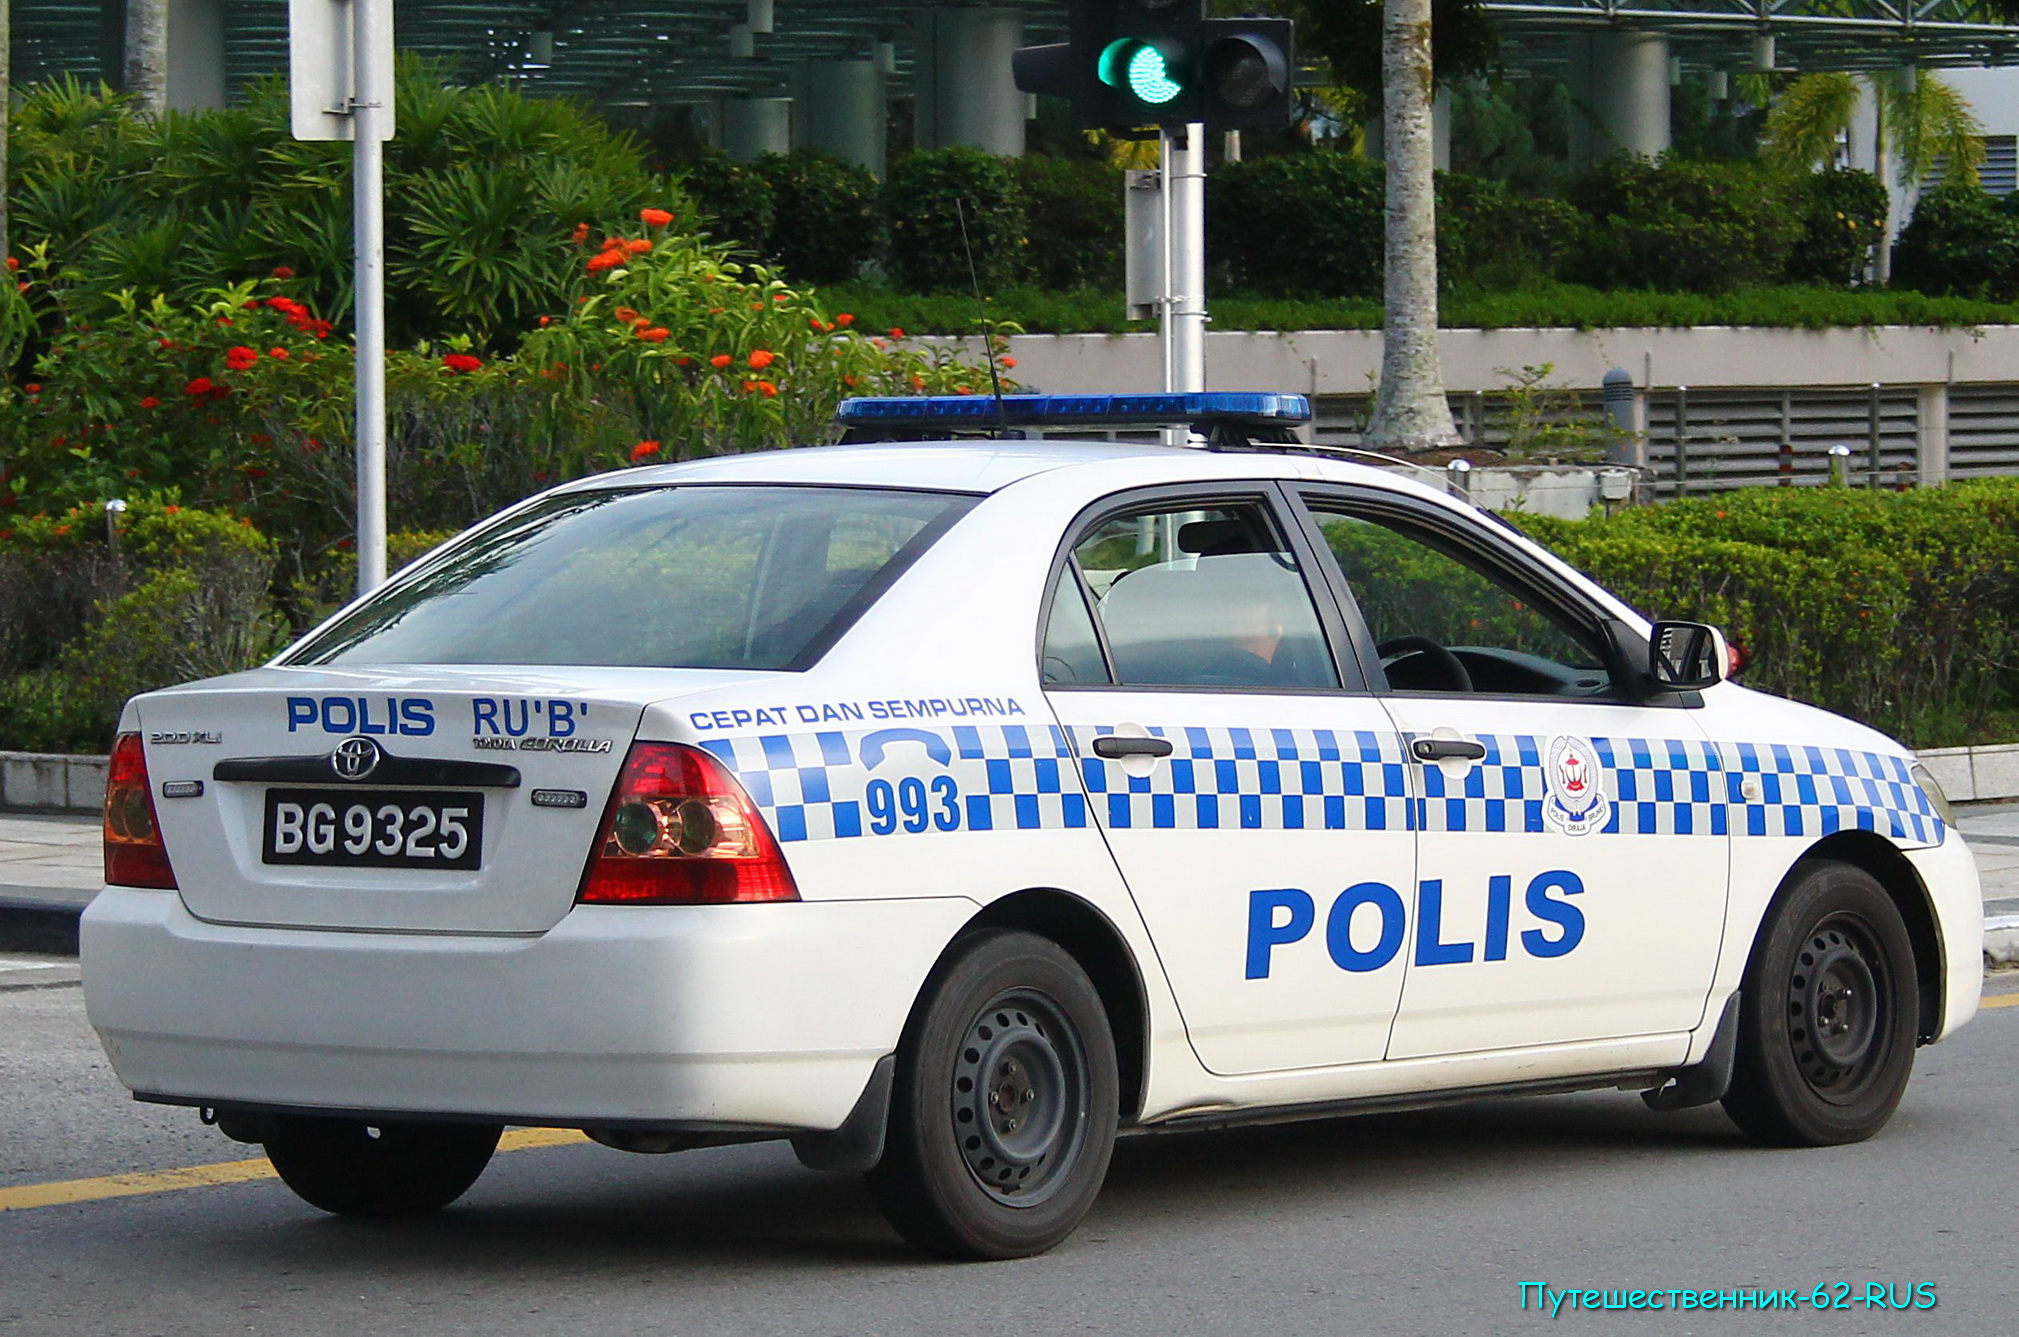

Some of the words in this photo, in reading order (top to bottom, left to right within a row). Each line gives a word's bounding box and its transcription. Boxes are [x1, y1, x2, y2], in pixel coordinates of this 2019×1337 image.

[286, 697, 436, 737] POLIS
[689, 706, 788, 731] CEPAT
[796, 702, 865, 724] DAN
[867, 697, 1026, 720] SEMPURNA
[520, 737, 613, 753] COROLLA
[865, 775, 961, 836] 993
[1245, 870, 1585, 980] POLIS
